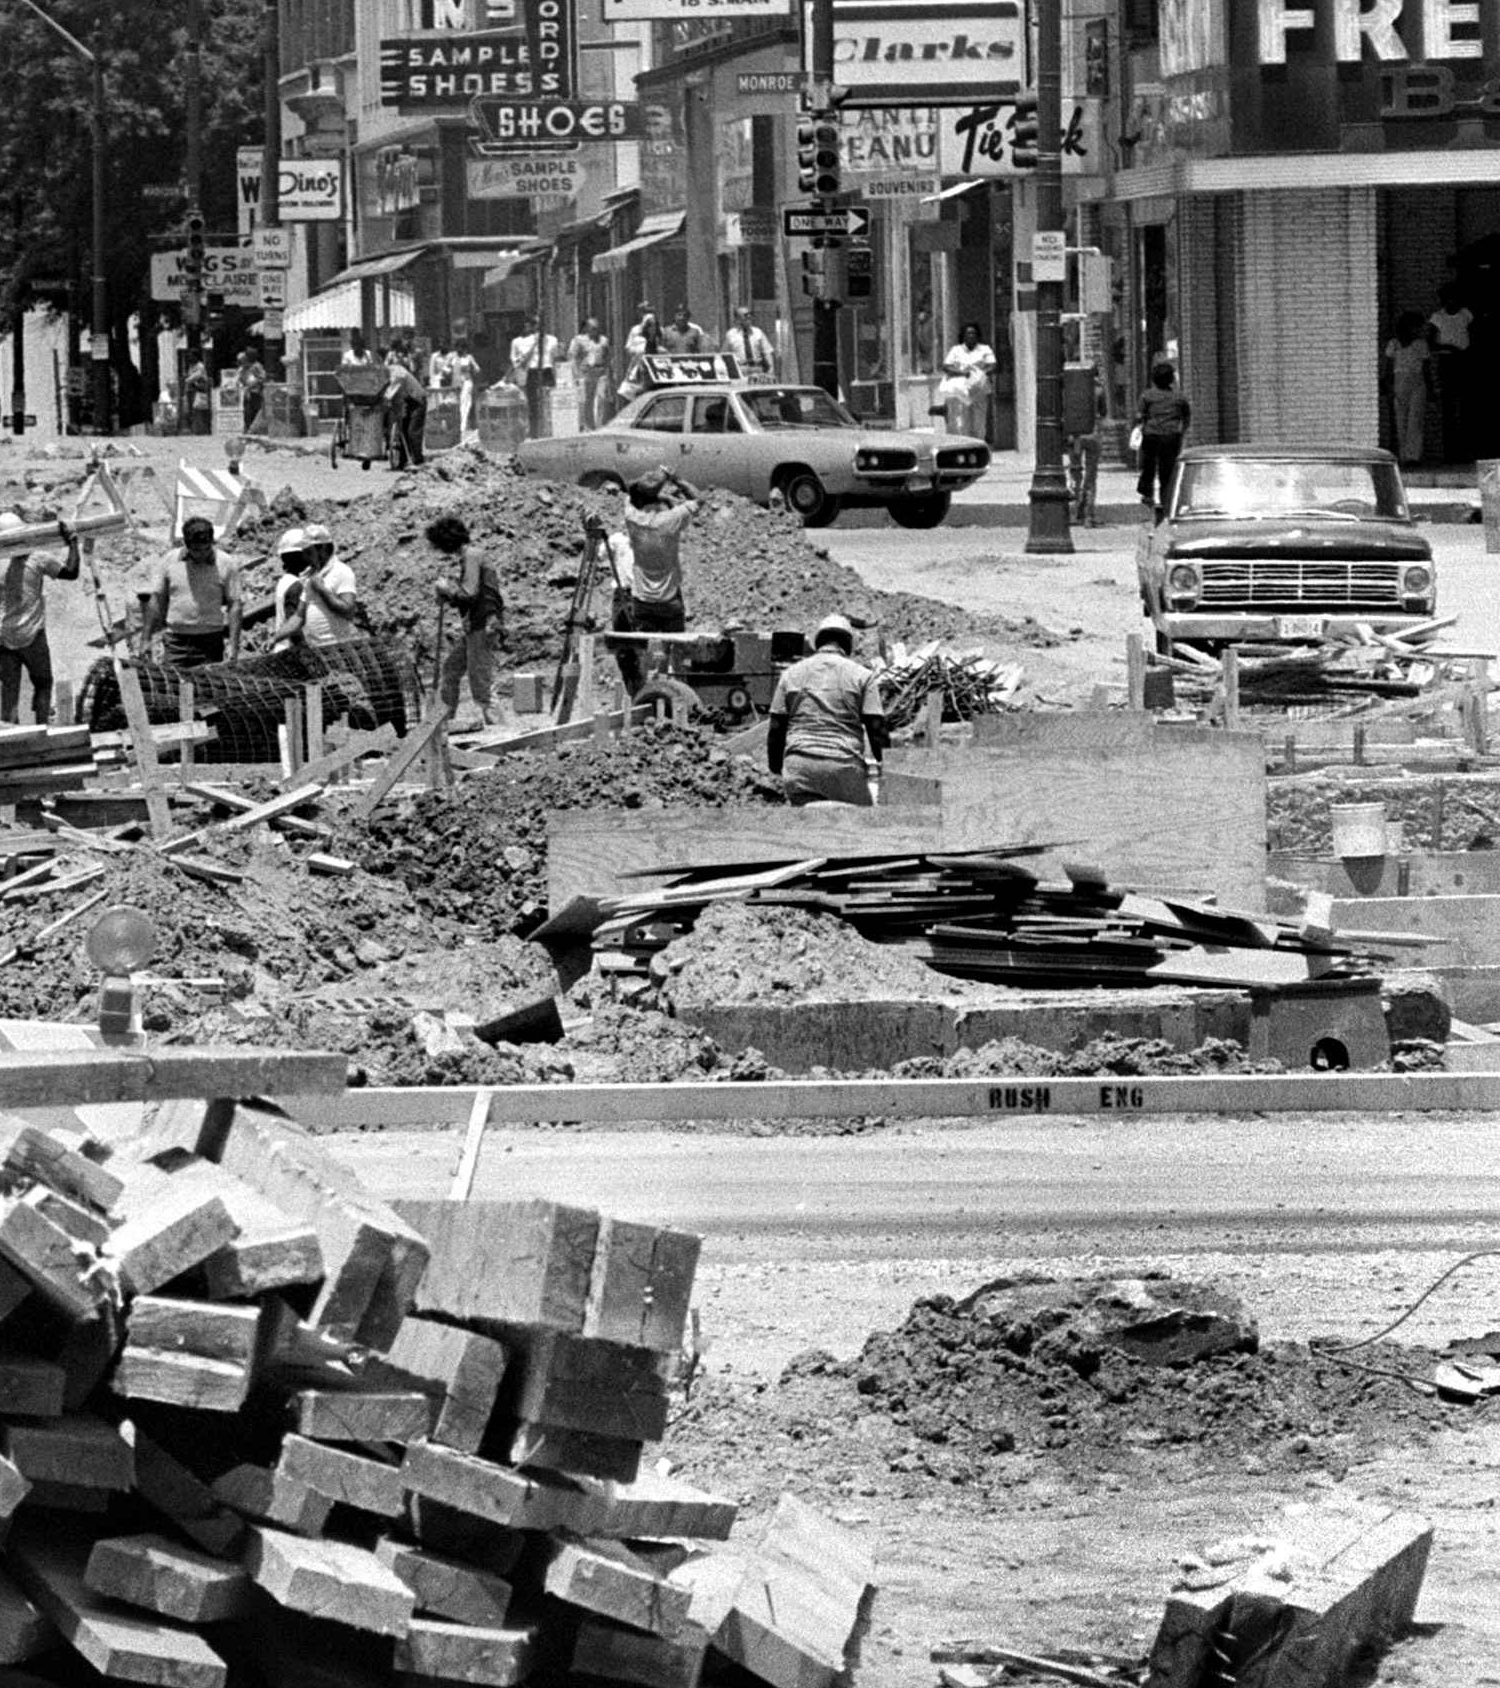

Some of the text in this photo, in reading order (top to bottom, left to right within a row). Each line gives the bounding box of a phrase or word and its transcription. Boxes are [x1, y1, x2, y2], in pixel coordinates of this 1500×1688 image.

[408, 46, 531, 67] SAMPLE
[832, 35, 1015, 61] Clarks
[408, 73, 533, 97] SHOES
[739, 75, 795, 91] MONROE
[499, 105, 626, 138] SHOES
[956, 107, 1004, 173] Tie
[510, 161, 577, 178] SAMPLE
[278, 170, 338, 198] Dino's
[516, 177, 573, 193] SHOES
[792, 217, 849, 231] ONE WAY
[262, 235, 281, 247] NO
[257, 250, 288, 261] TURNS
[989, 1085, 1144, 1110] RUSH ENG
